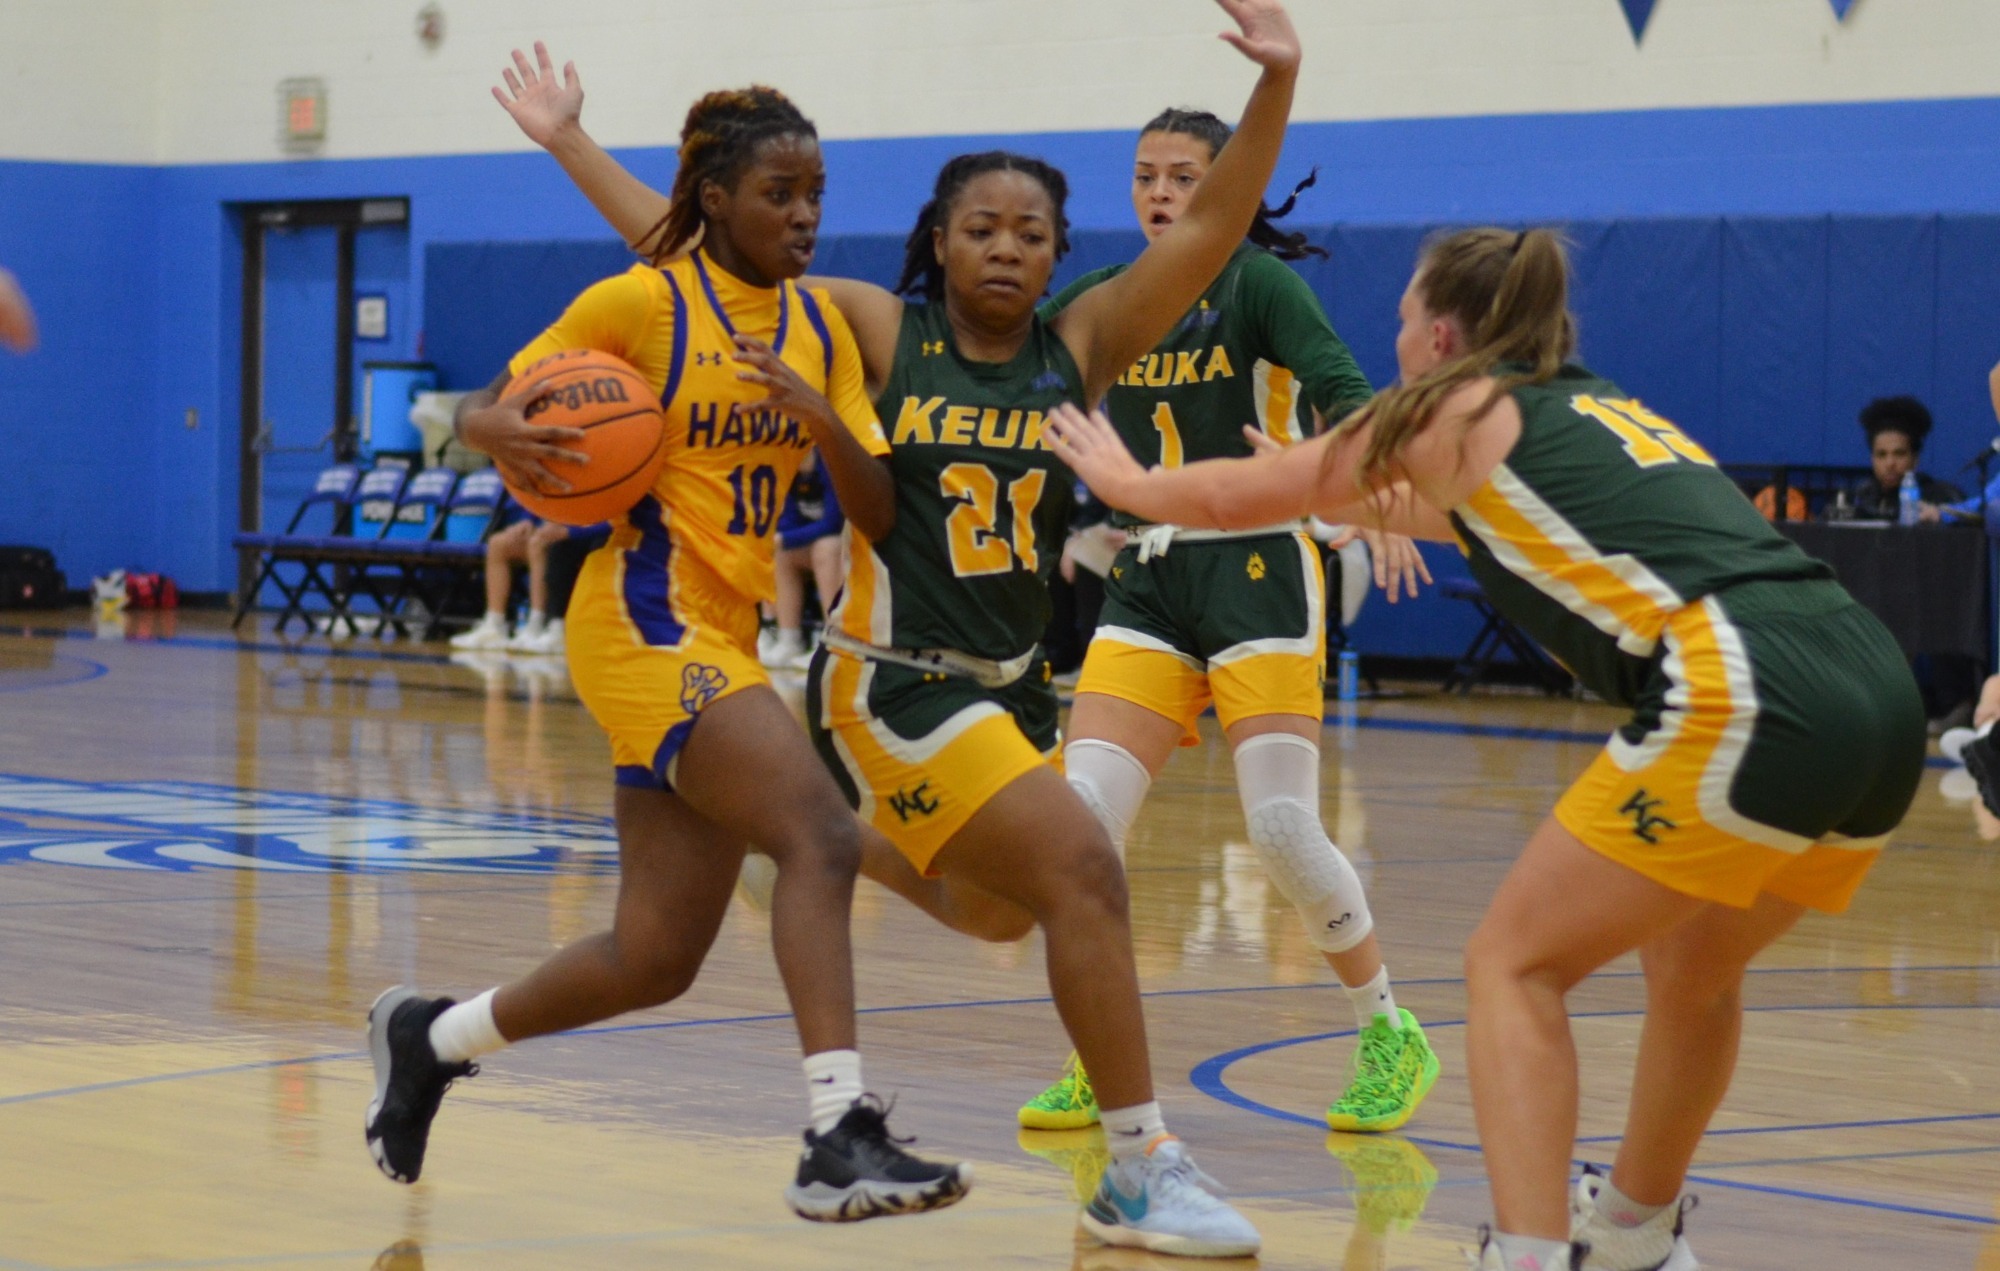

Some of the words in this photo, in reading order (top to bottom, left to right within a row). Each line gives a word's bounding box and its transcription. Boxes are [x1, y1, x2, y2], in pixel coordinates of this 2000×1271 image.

[1117, 344, 1235, 387] EUKA
[686, 402, 811, 448] HAWK
[892, 396, 1068, 451] KEUK
[1151, 401, 1184, 469] 1
[1569, 394, 1717, 469] 15
[727, 464, 777, 538] 10
[938, 462, 1047, 578] 21
